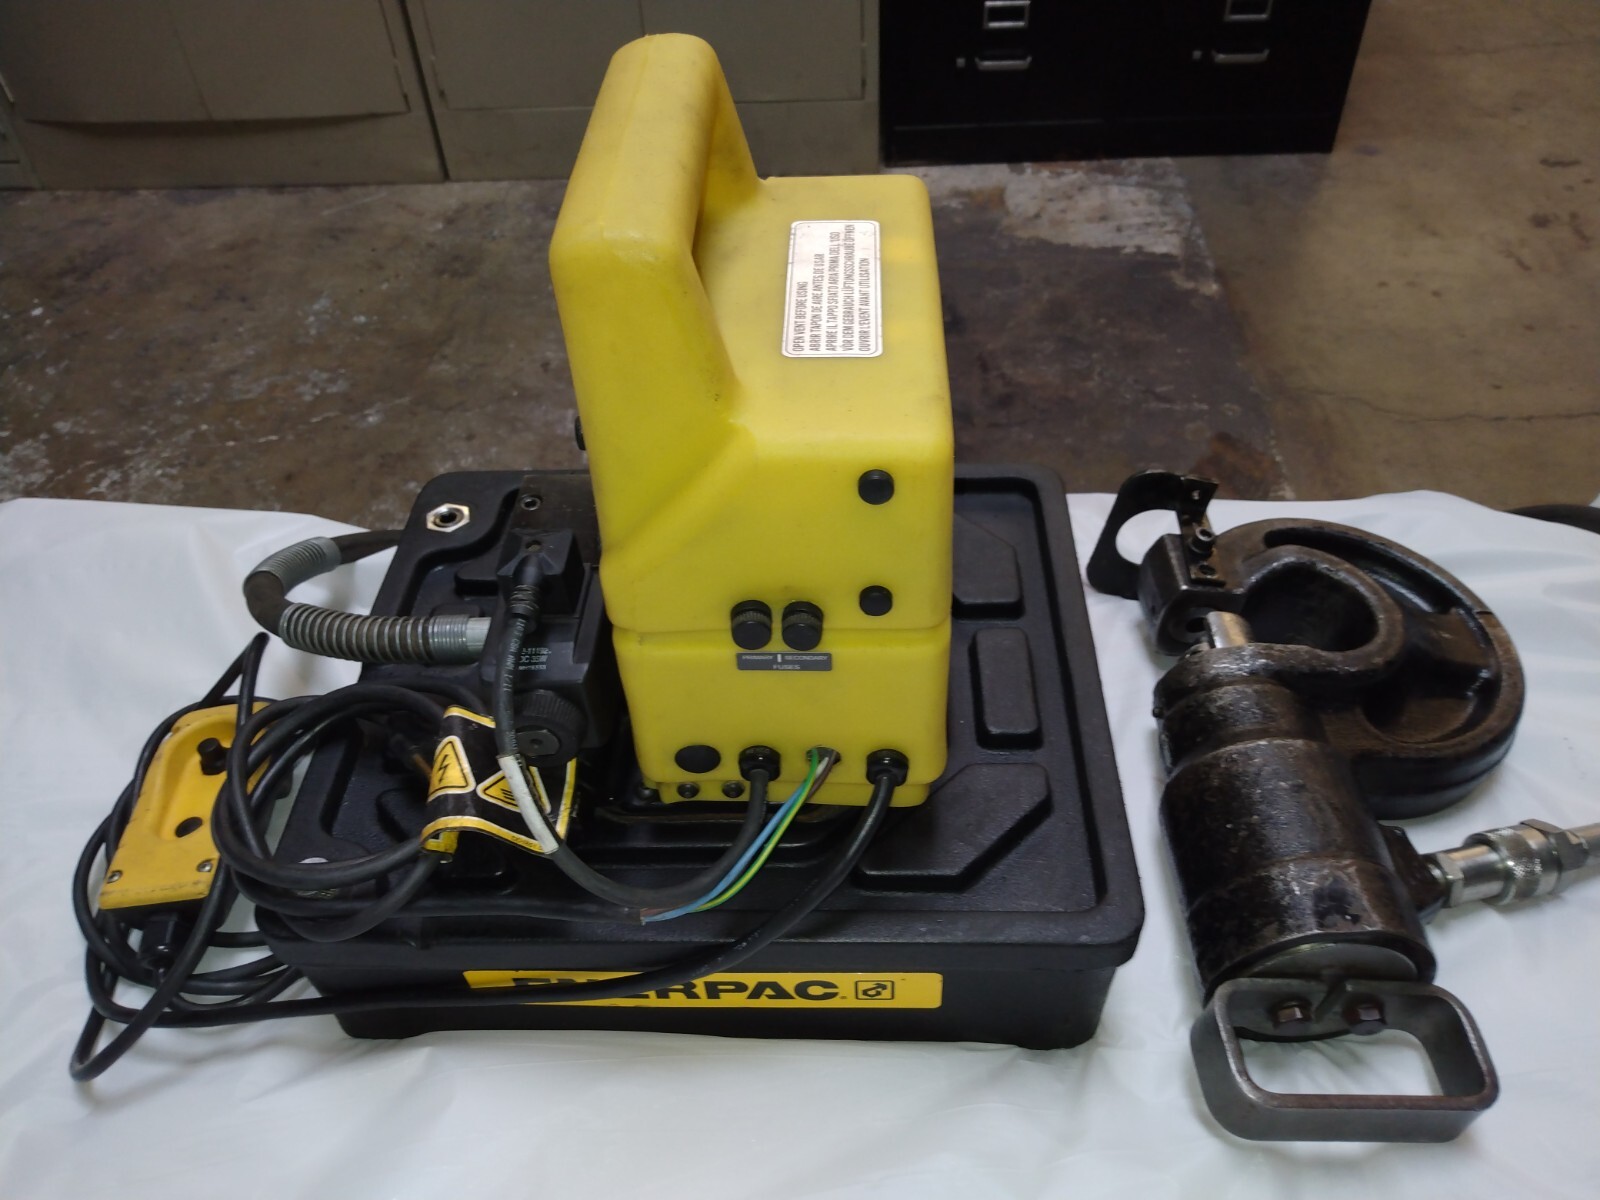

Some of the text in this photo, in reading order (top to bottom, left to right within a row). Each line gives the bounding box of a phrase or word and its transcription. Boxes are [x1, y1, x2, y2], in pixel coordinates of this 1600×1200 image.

[828, 256, 840, 272] PRIMA
[858, 257, 870, 289] UTILISATION
[828, 273, 839, 285] ARIA
[809, 253, 825, 351] ABRIR TAPON DE AIRE ANTES DE USAR
[827, 285, 839, 304] SFIATO
[858, 289, 870, 307] AVANT
[792, 281, 808, 351] OPEN VENT BEFORE USING
[826, 305, 839, 323] TAPPO
[842, 295, 854, 325] GEBRAUCH
[825, 330, 838, 351] APRIRE
[842, 326, 854, 338] DEM
[858, 330, 871, 351] OUVRIR
[512, 978, 840, 1001] RPAC
